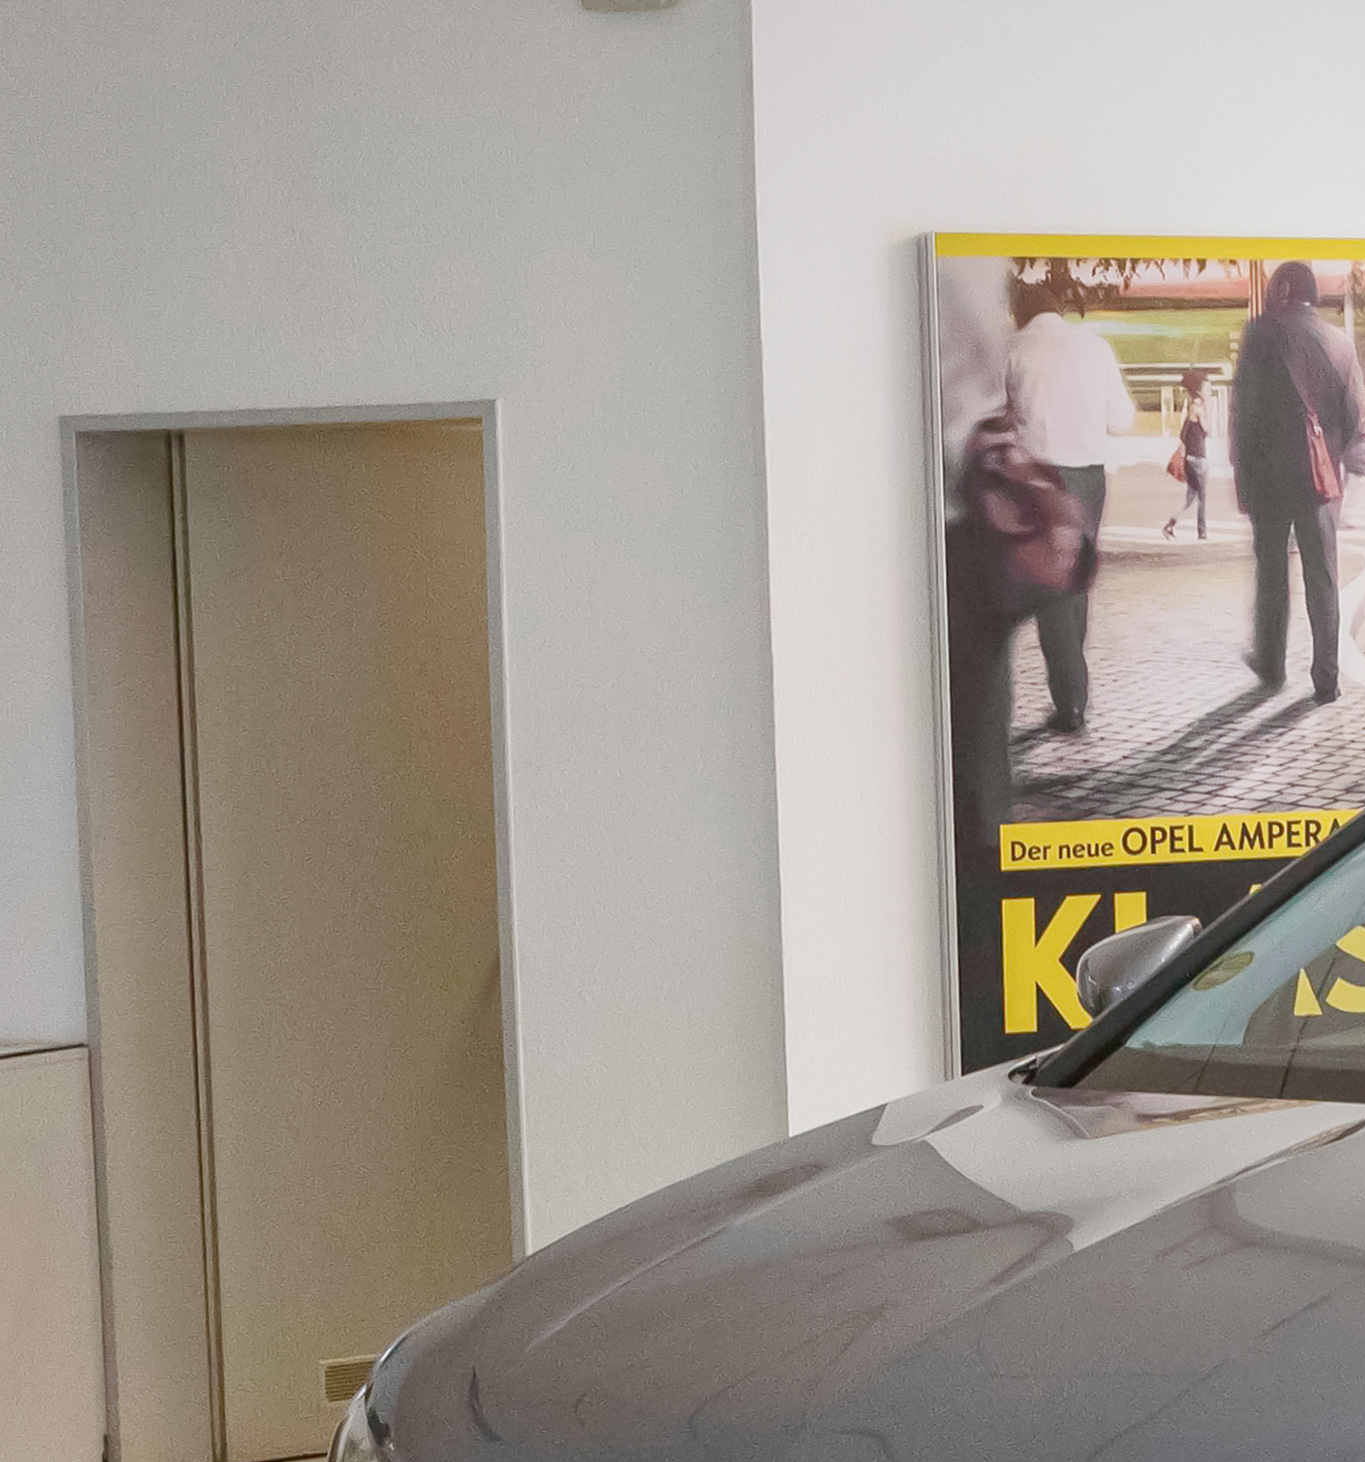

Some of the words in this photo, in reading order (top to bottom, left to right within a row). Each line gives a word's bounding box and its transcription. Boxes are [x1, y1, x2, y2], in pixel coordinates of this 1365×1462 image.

[1010, 840, 1051, 862] Der
[1058, 841, 1115, 860] neue
[1122, 824, 1204, 856] OPEL
